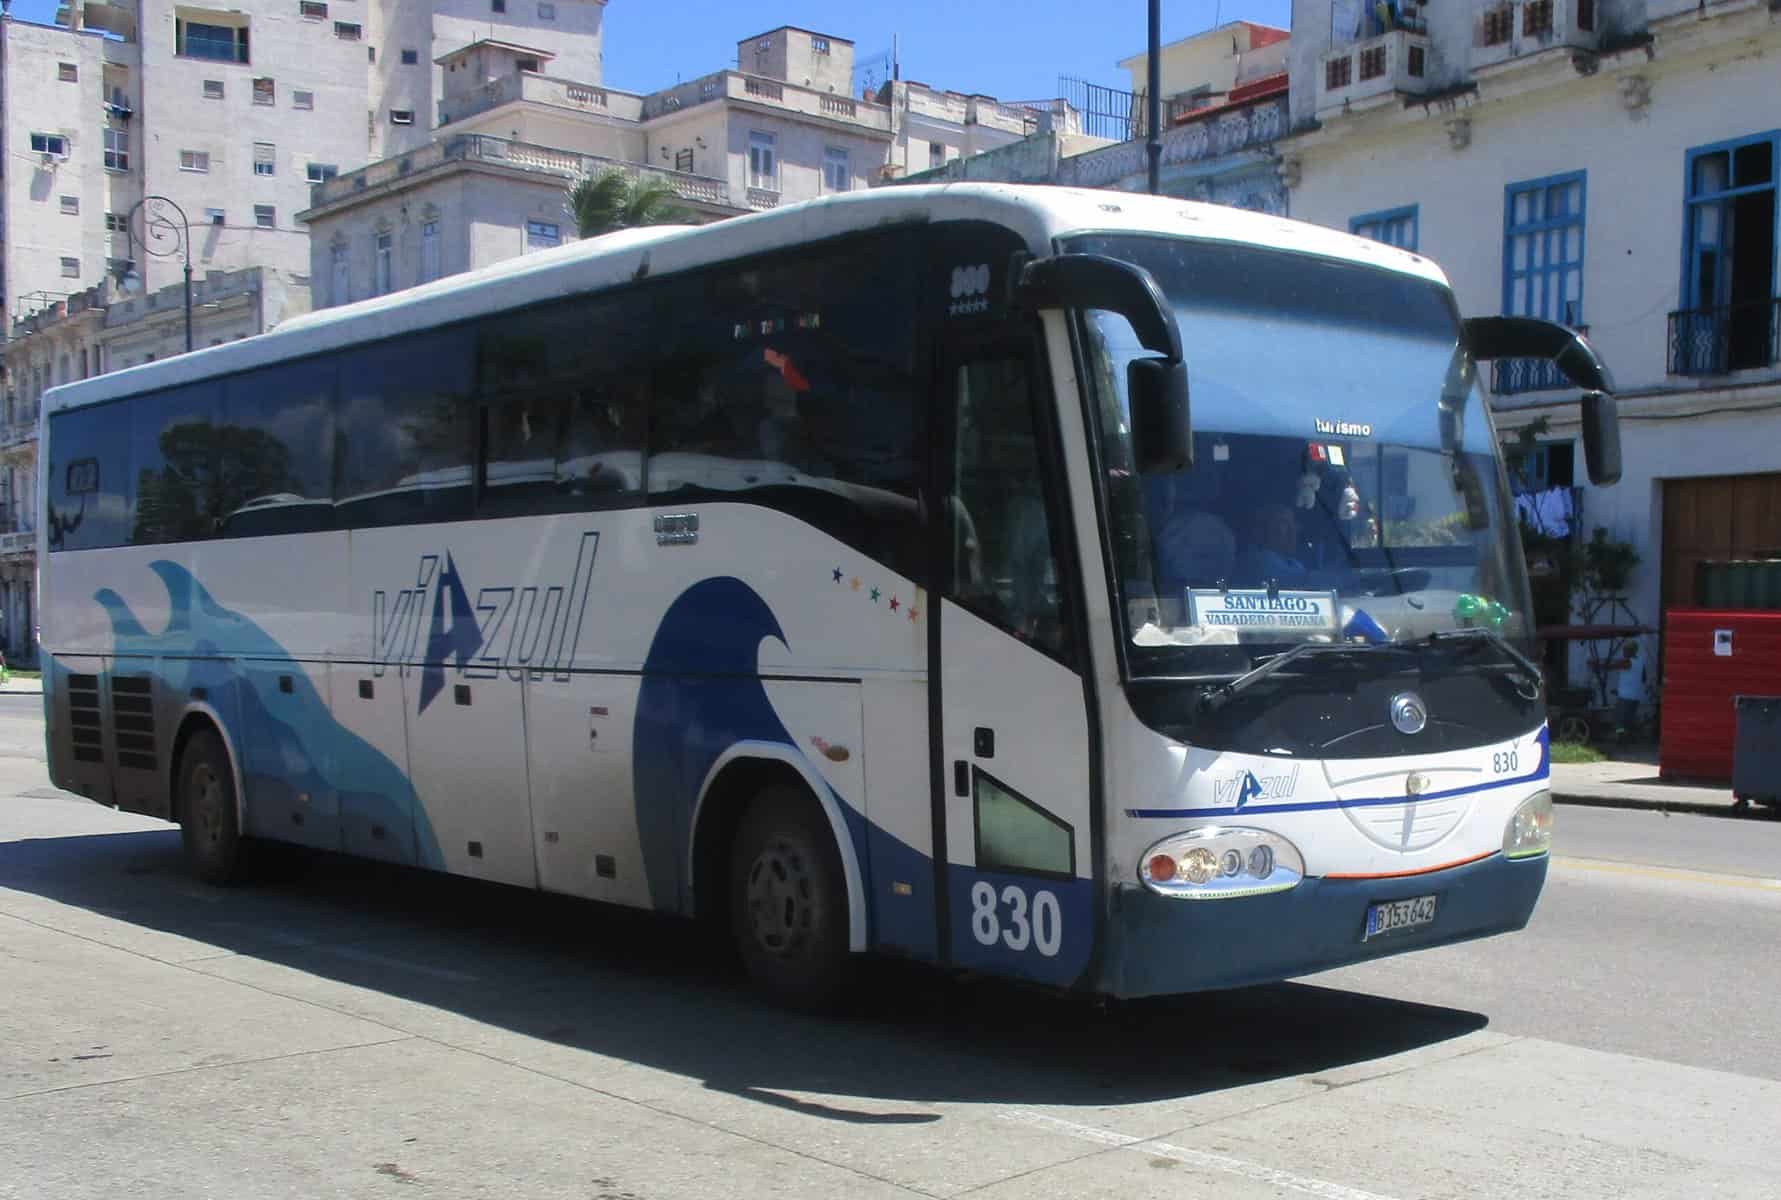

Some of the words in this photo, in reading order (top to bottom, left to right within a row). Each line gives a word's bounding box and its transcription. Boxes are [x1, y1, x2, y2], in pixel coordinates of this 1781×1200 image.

[1314, 416, 1371, 436] turismo
[1224, 595, 1307, 611] SANTIAGO
[1205, 614, 1276, 626] VARADERO
[1279, 615, 1328, 627] HAVANA
[1493, 750, 1518, 774] 830
[970, 880, 1062, 957] 830
